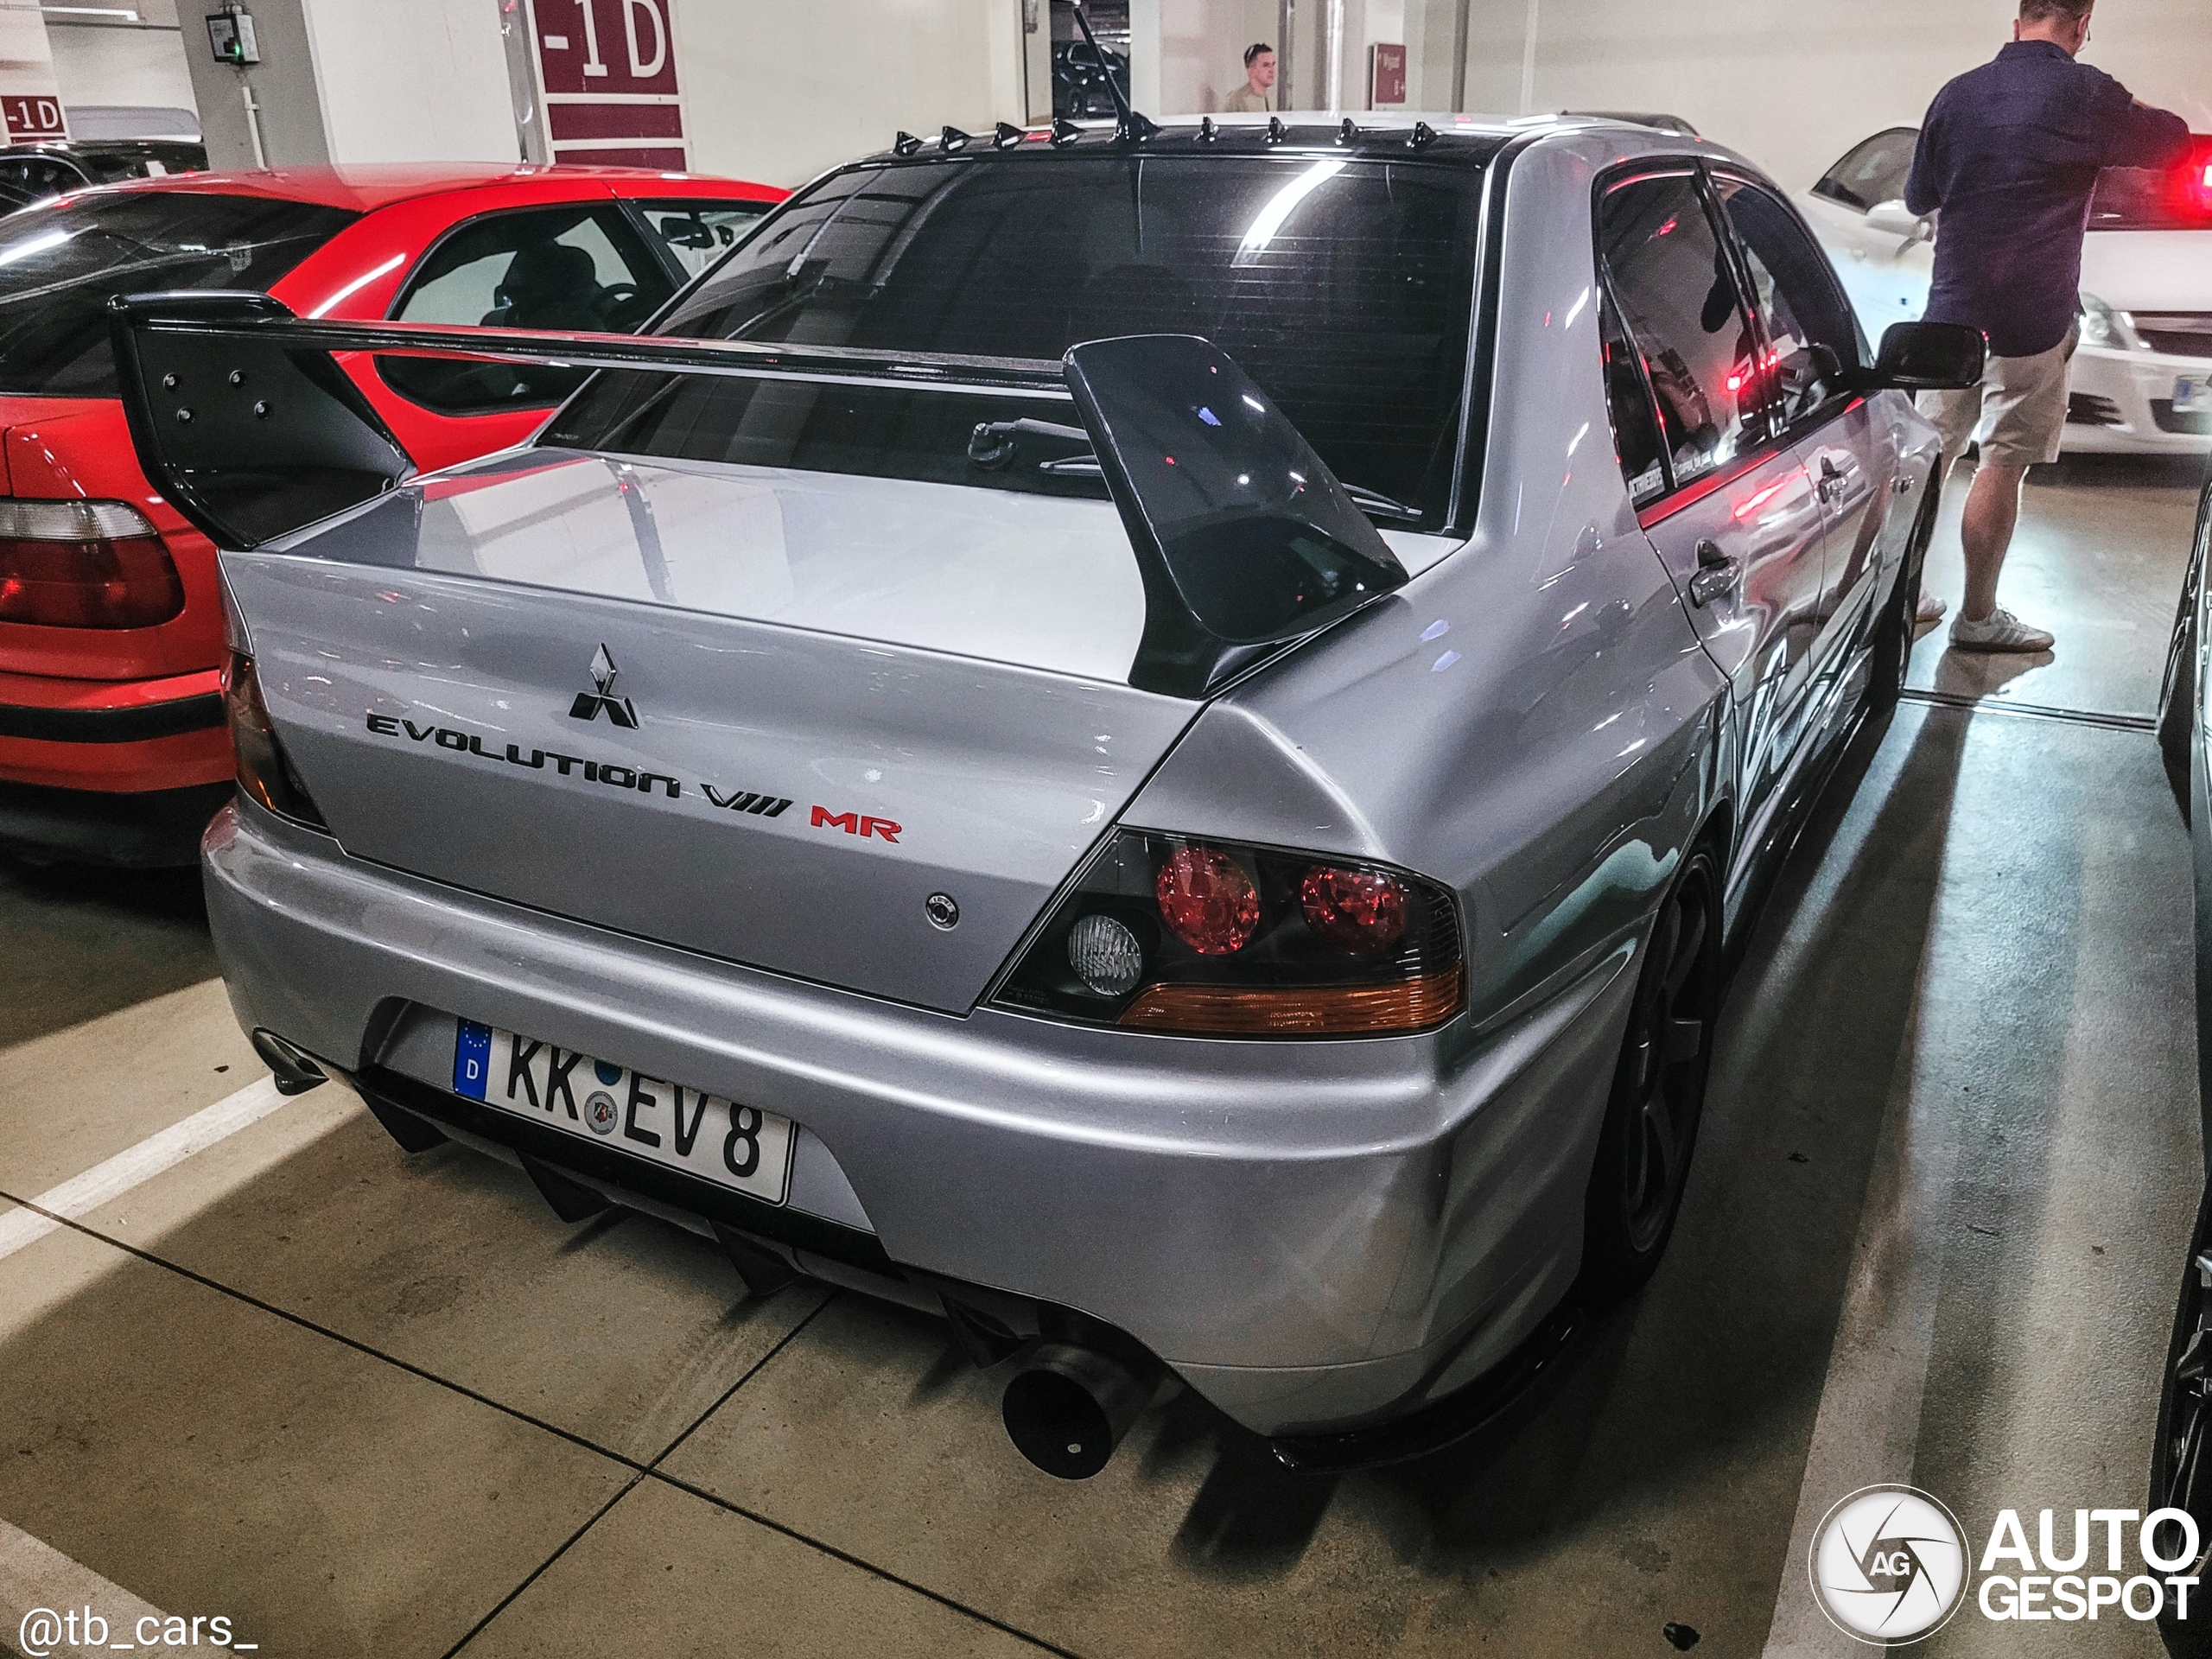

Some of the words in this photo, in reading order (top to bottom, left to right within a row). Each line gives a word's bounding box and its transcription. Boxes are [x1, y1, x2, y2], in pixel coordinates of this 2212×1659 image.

[366, 713, 680, 799] EVOLUTION
[701, 783, 793, 817] VIII
[810, 805, 903, 843] MR
[466, 1058, 480, 1080] D
[506, 1033, 584, 1121] KK
[624, 1071, 709, 1157] EV
[723, 1103, 764, 1178] 8
